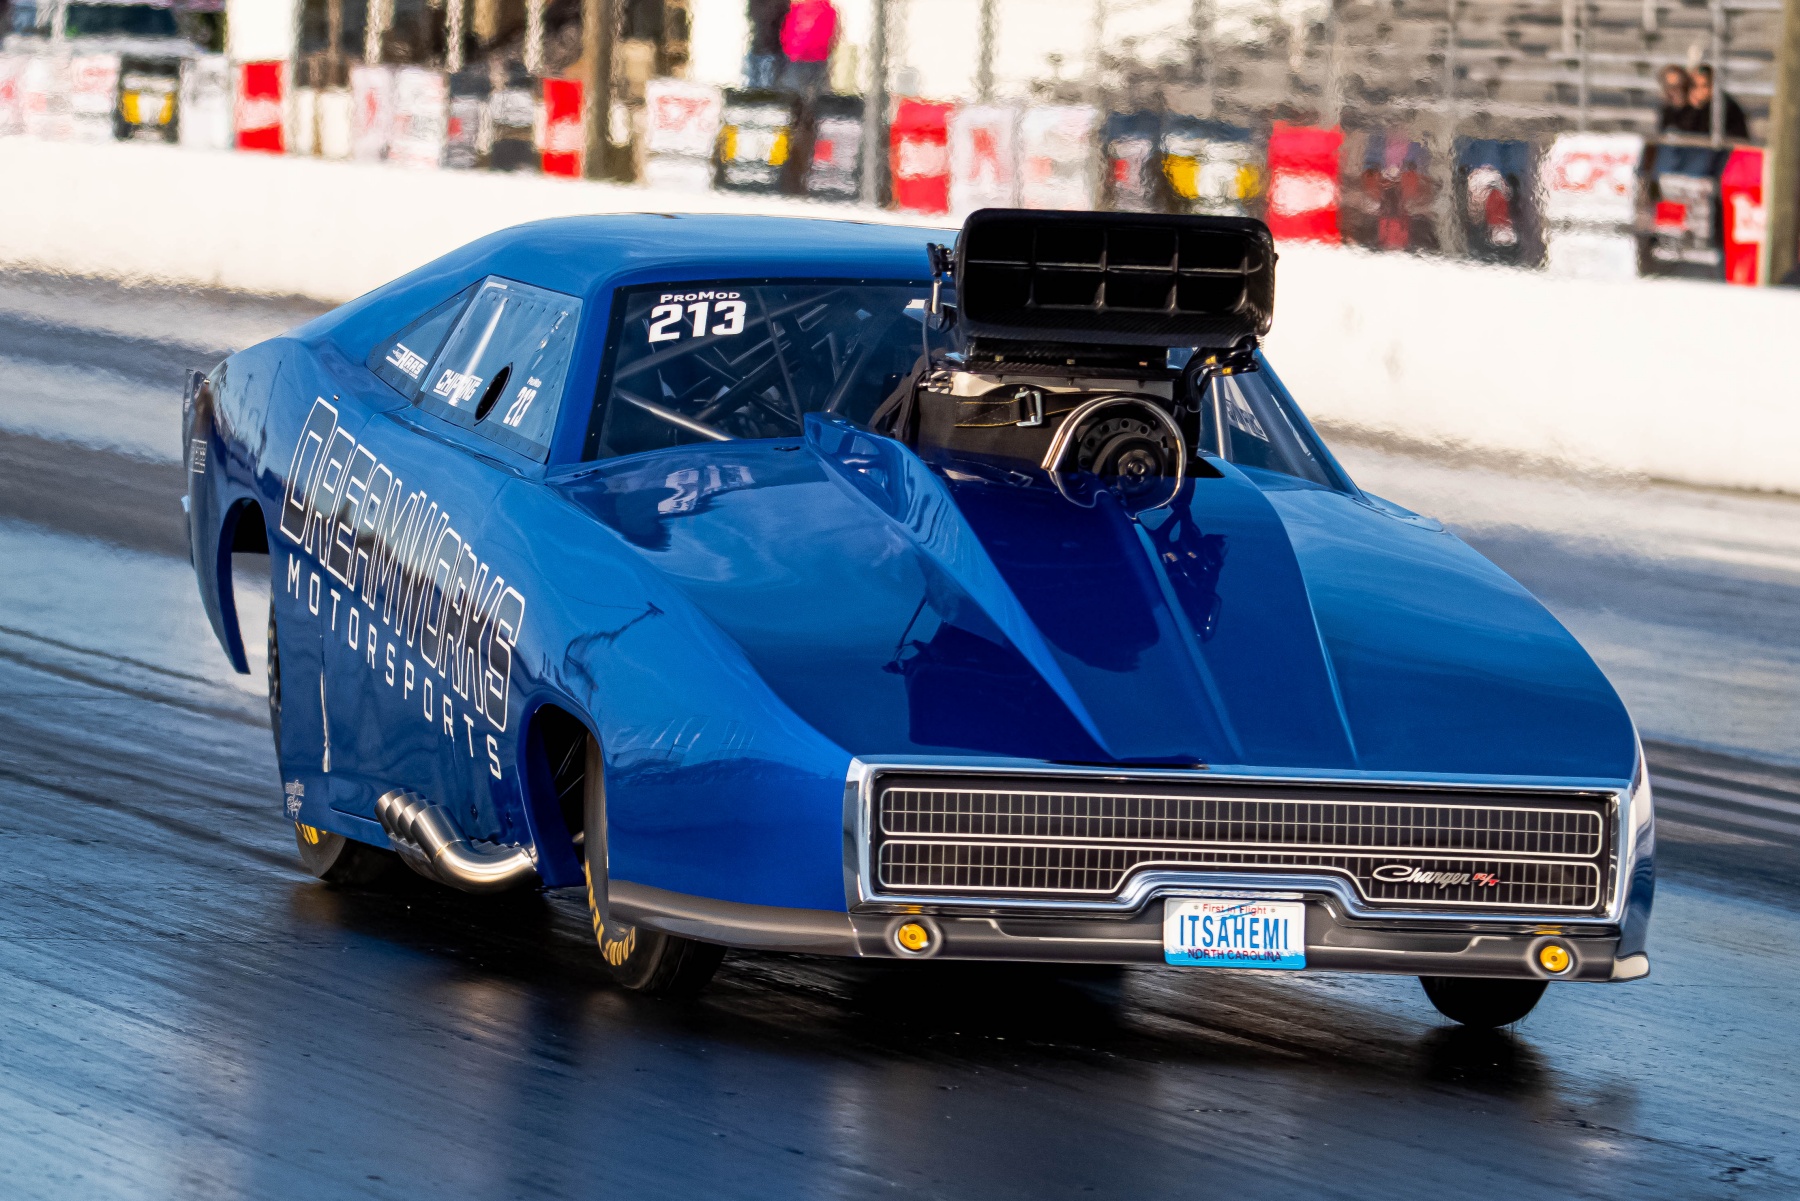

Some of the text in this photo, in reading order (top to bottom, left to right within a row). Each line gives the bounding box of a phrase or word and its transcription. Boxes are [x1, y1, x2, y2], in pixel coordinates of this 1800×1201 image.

[648, 300, 747, 343] 213
[502, 386, 537, 428] 213
[280, 396, 526, 733] DREAMWORKS
[286, 553, 502, 780] MOTORSPORTS
[1372, 864, 1471, 889] Charger
[1202, 903, 1267, 916] First in Flight
[1180, 914, 1289, 950] ITSAHEMI
[1187, 948, 1283, 963] NORTH CAROLINA
